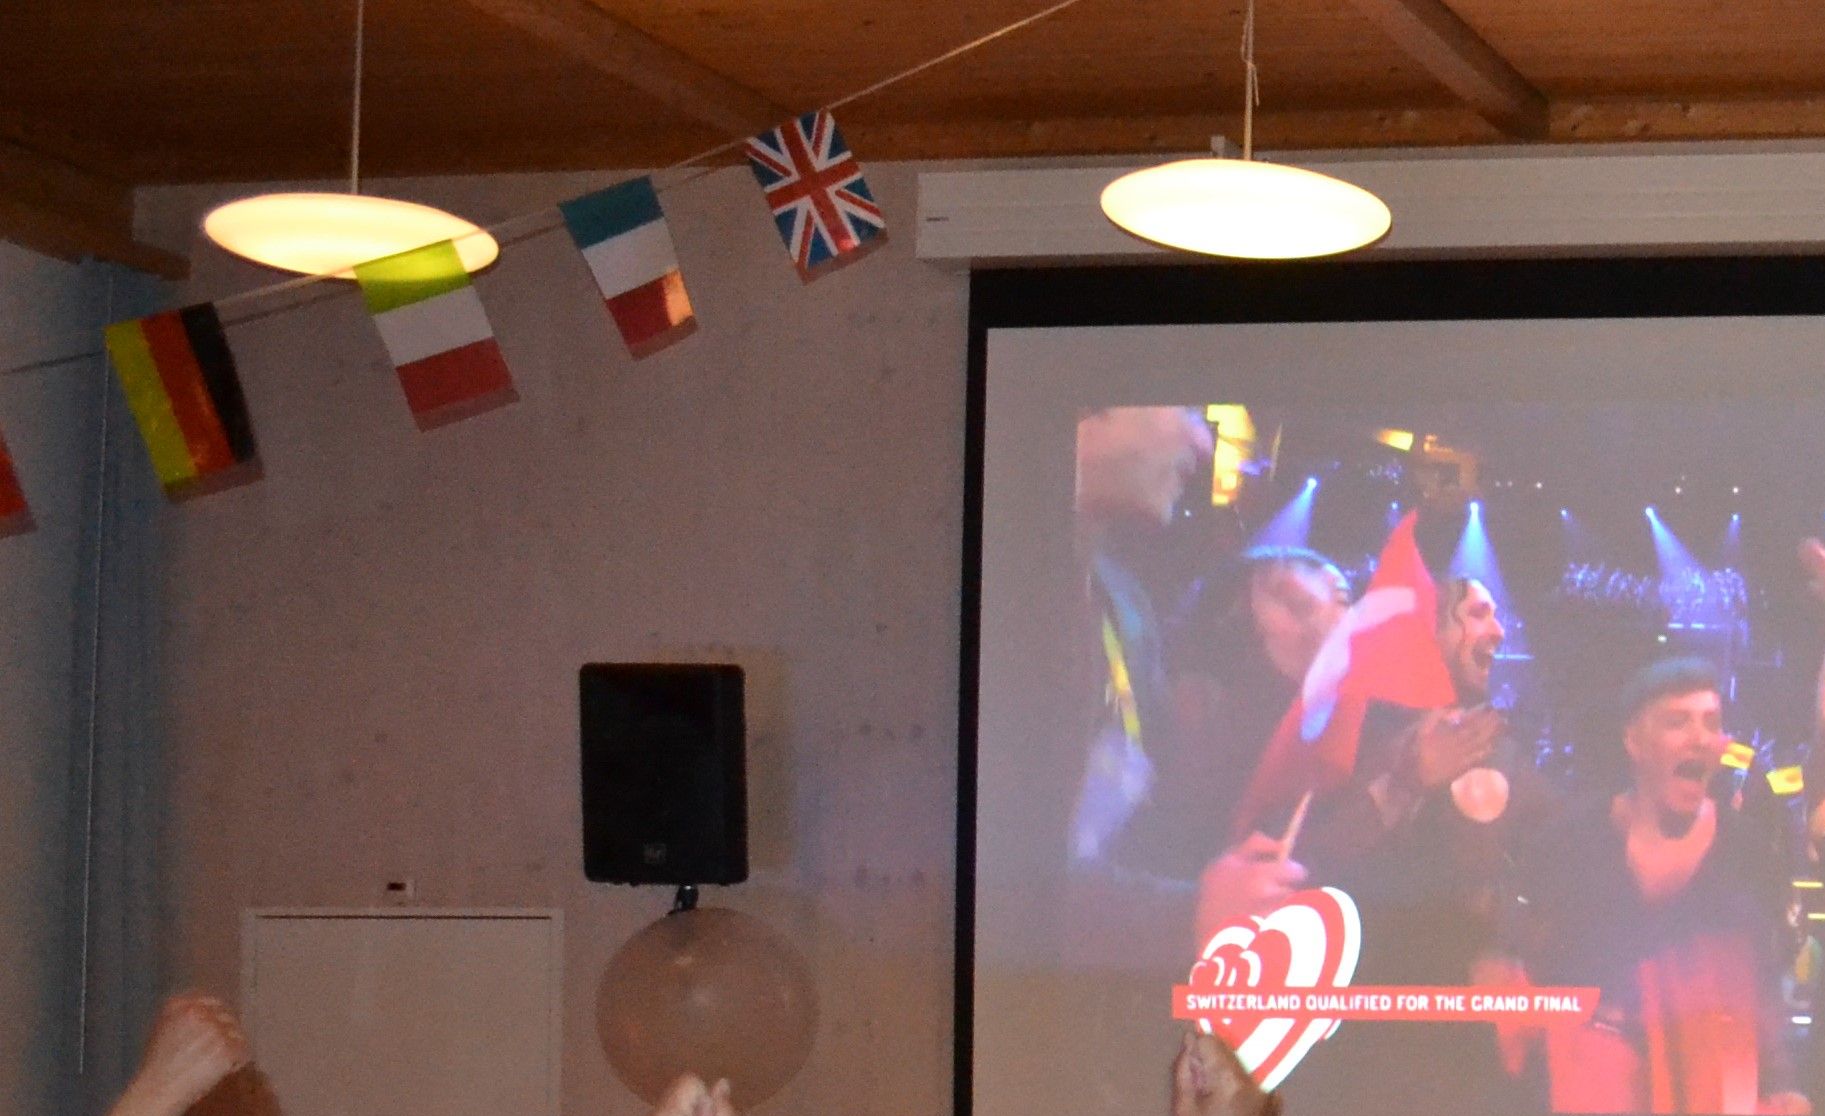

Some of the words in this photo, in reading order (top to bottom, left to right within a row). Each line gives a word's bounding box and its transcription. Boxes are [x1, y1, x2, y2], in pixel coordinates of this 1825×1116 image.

[1186, 994, 1301, 1011] SWITZERLAND
[1305, 994, 1392, 1012] QUALIFIED
[1396, 994, 1429, 1012] FOR
[1434, 995, 1465, 1012] THE
[1471, 995, 1529, 1012] GRAND
[1533, 995, 1582, 1013] FINAL
